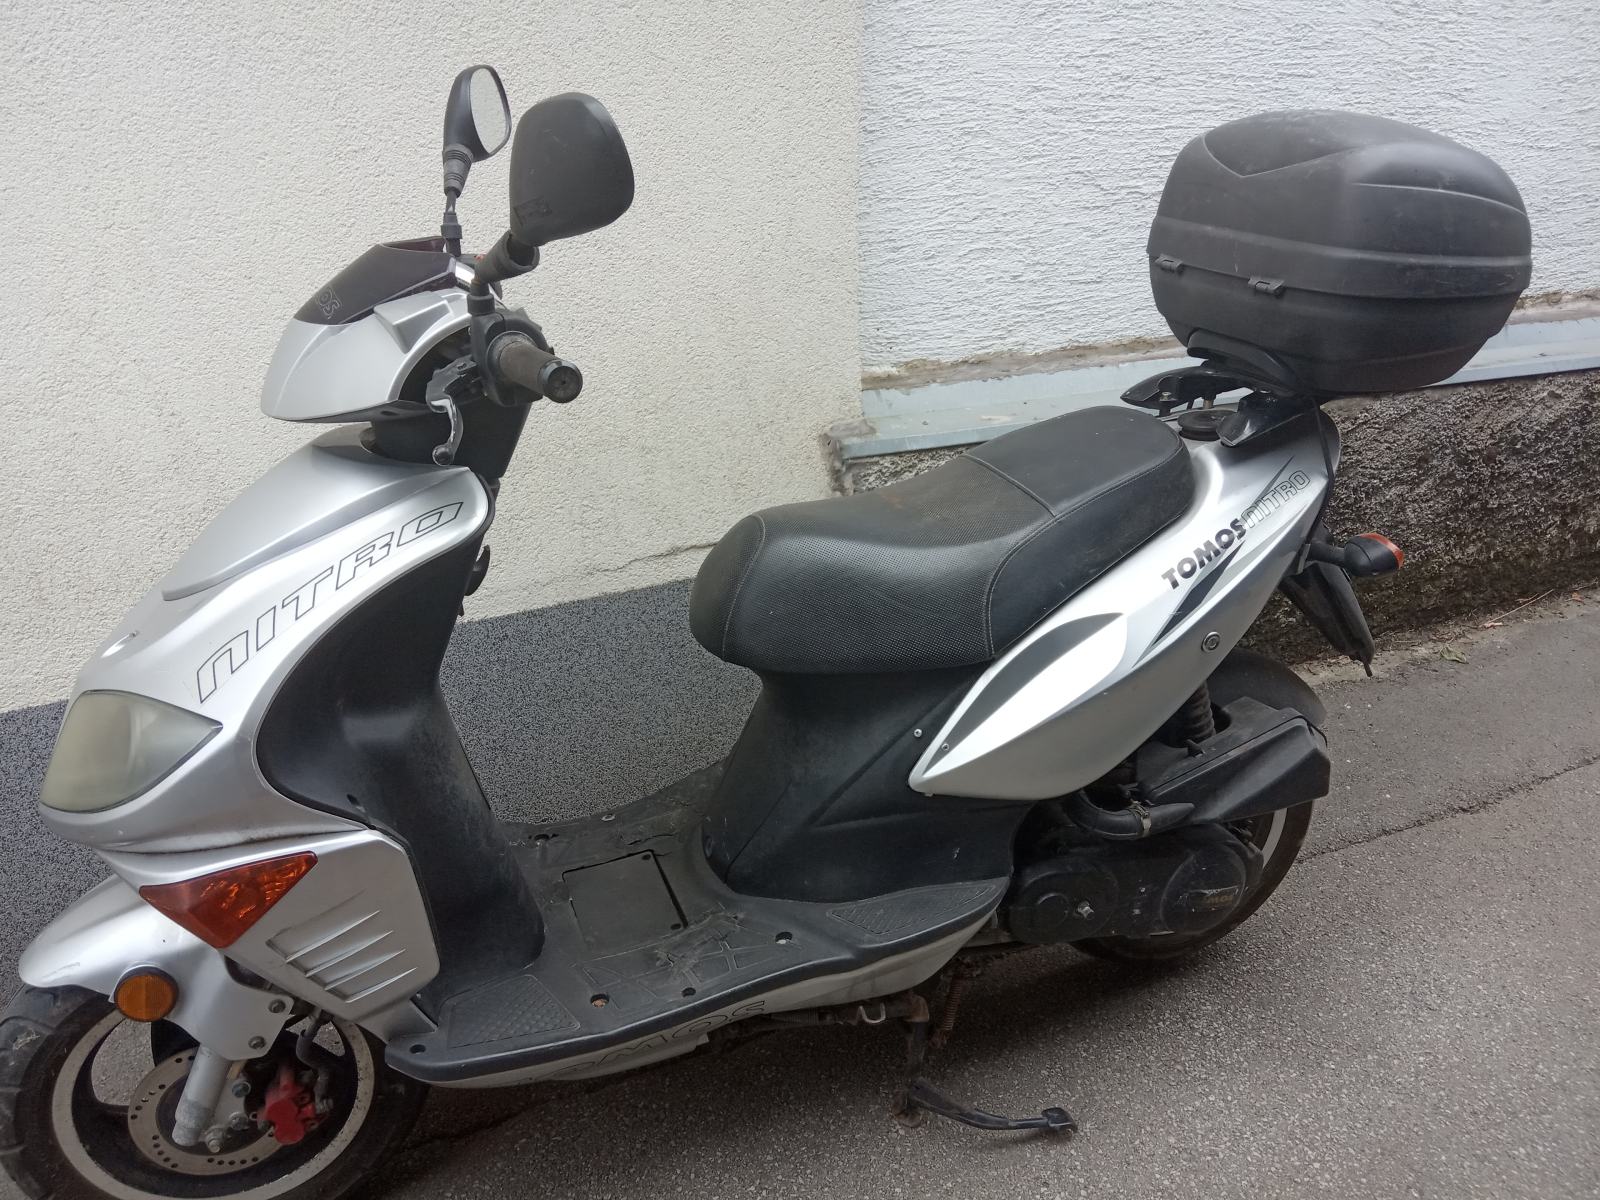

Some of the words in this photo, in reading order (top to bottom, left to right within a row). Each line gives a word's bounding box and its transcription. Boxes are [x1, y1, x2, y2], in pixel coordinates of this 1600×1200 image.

[197, 501, 464, 704] NITRO
[1161, 518, 1247, 590] TOMOS
[1241, 469, 1310, 530] NITRO
